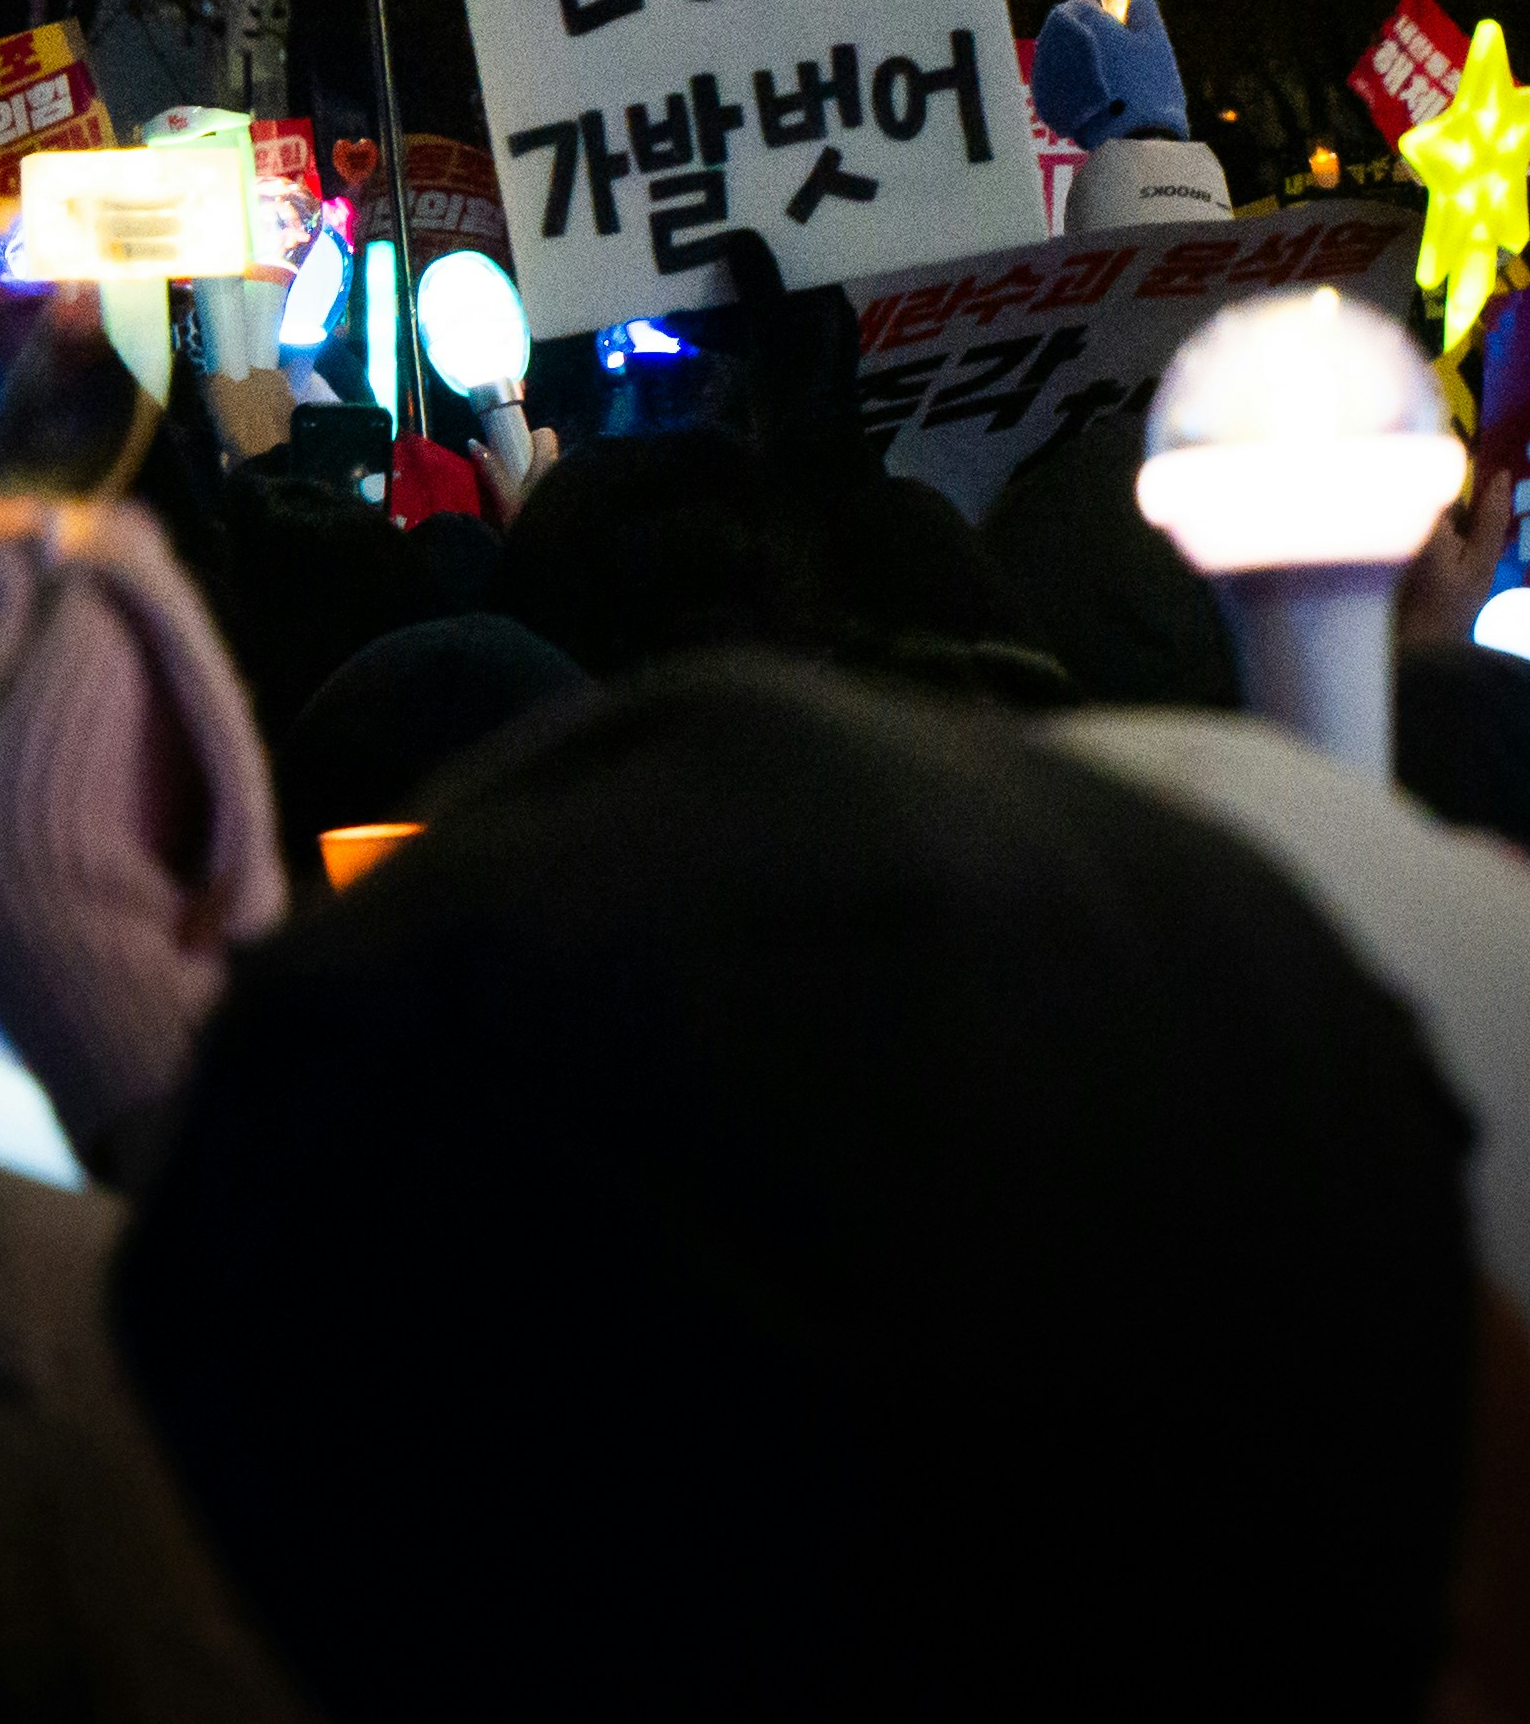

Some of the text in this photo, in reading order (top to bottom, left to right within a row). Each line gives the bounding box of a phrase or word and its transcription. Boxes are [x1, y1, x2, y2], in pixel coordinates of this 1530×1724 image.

[505, 28, 995, 276] 가발벗어
[1139, 183, 1212, 205] BROOKS
[1133, 220, 1407, 299] 윤석열
